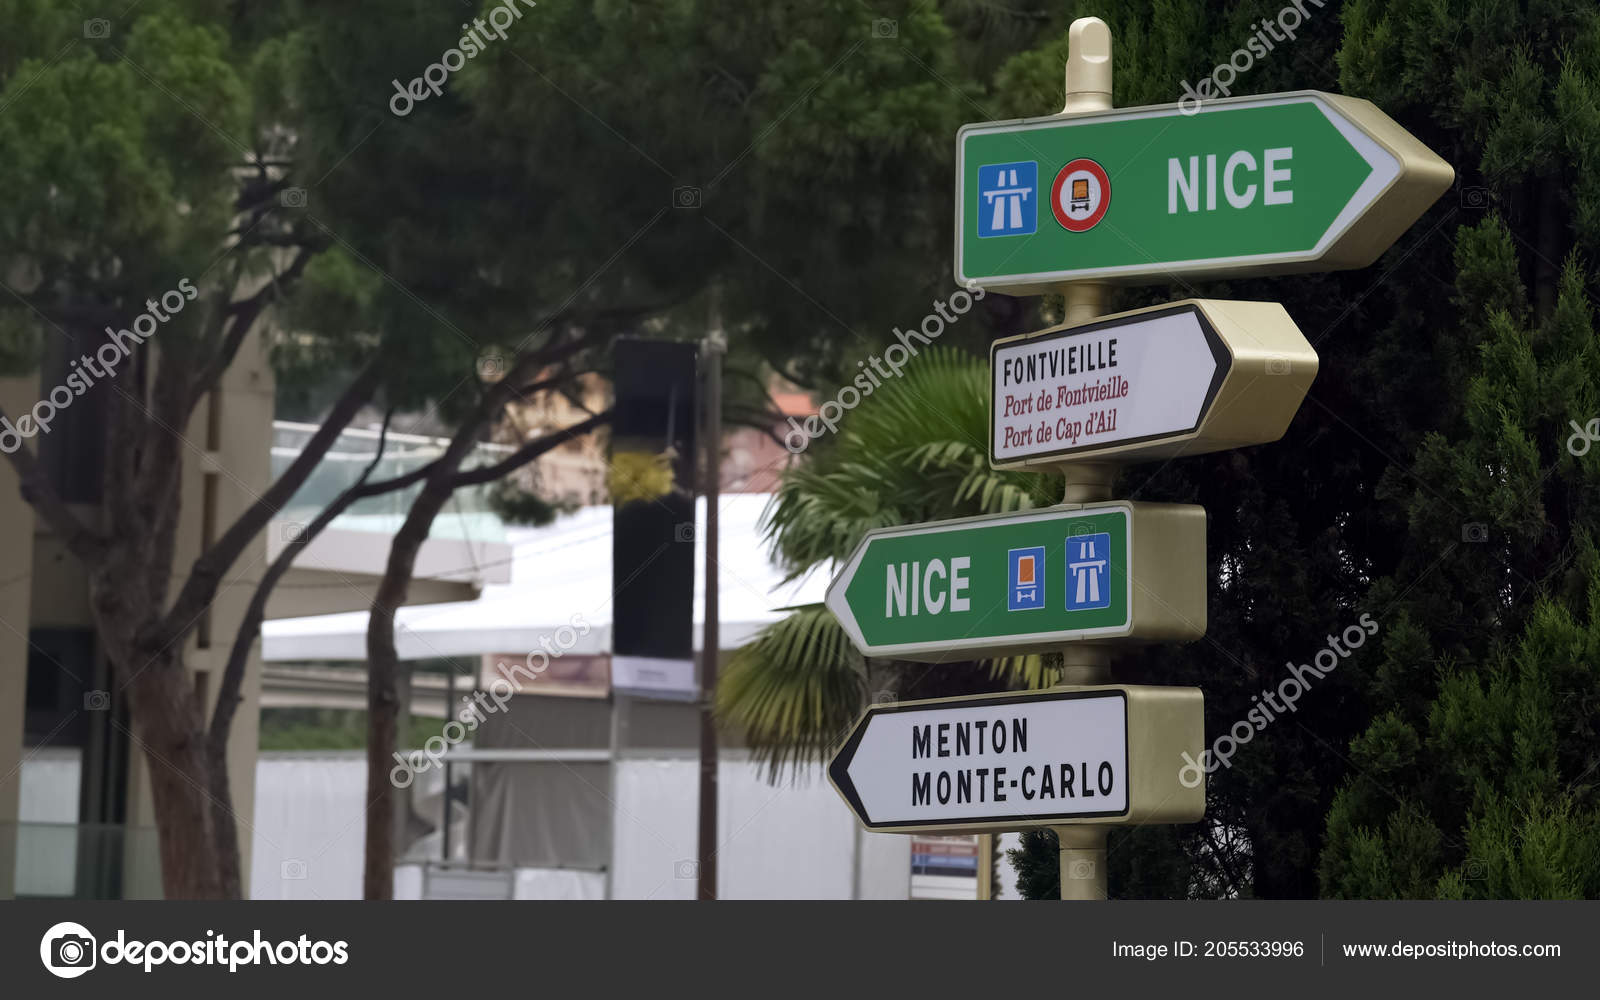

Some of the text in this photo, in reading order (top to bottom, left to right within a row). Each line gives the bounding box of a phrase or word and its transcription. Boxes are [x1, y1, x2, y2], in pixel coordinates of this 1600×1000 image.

[1167, 146, 1294, 214] NICE
[1003, 338, 1118, 386] FONTVIEILLE
[1003, 375, 1129, 417] Port de Fontvieille
[1003, 408, 1117, 448] Port de Cap d'Ail
[885, 556, 971, 618] NICE
[912, 718, 1028, 759] MENTON
[912, 761, 1114, 807] MONTE-CARLO
